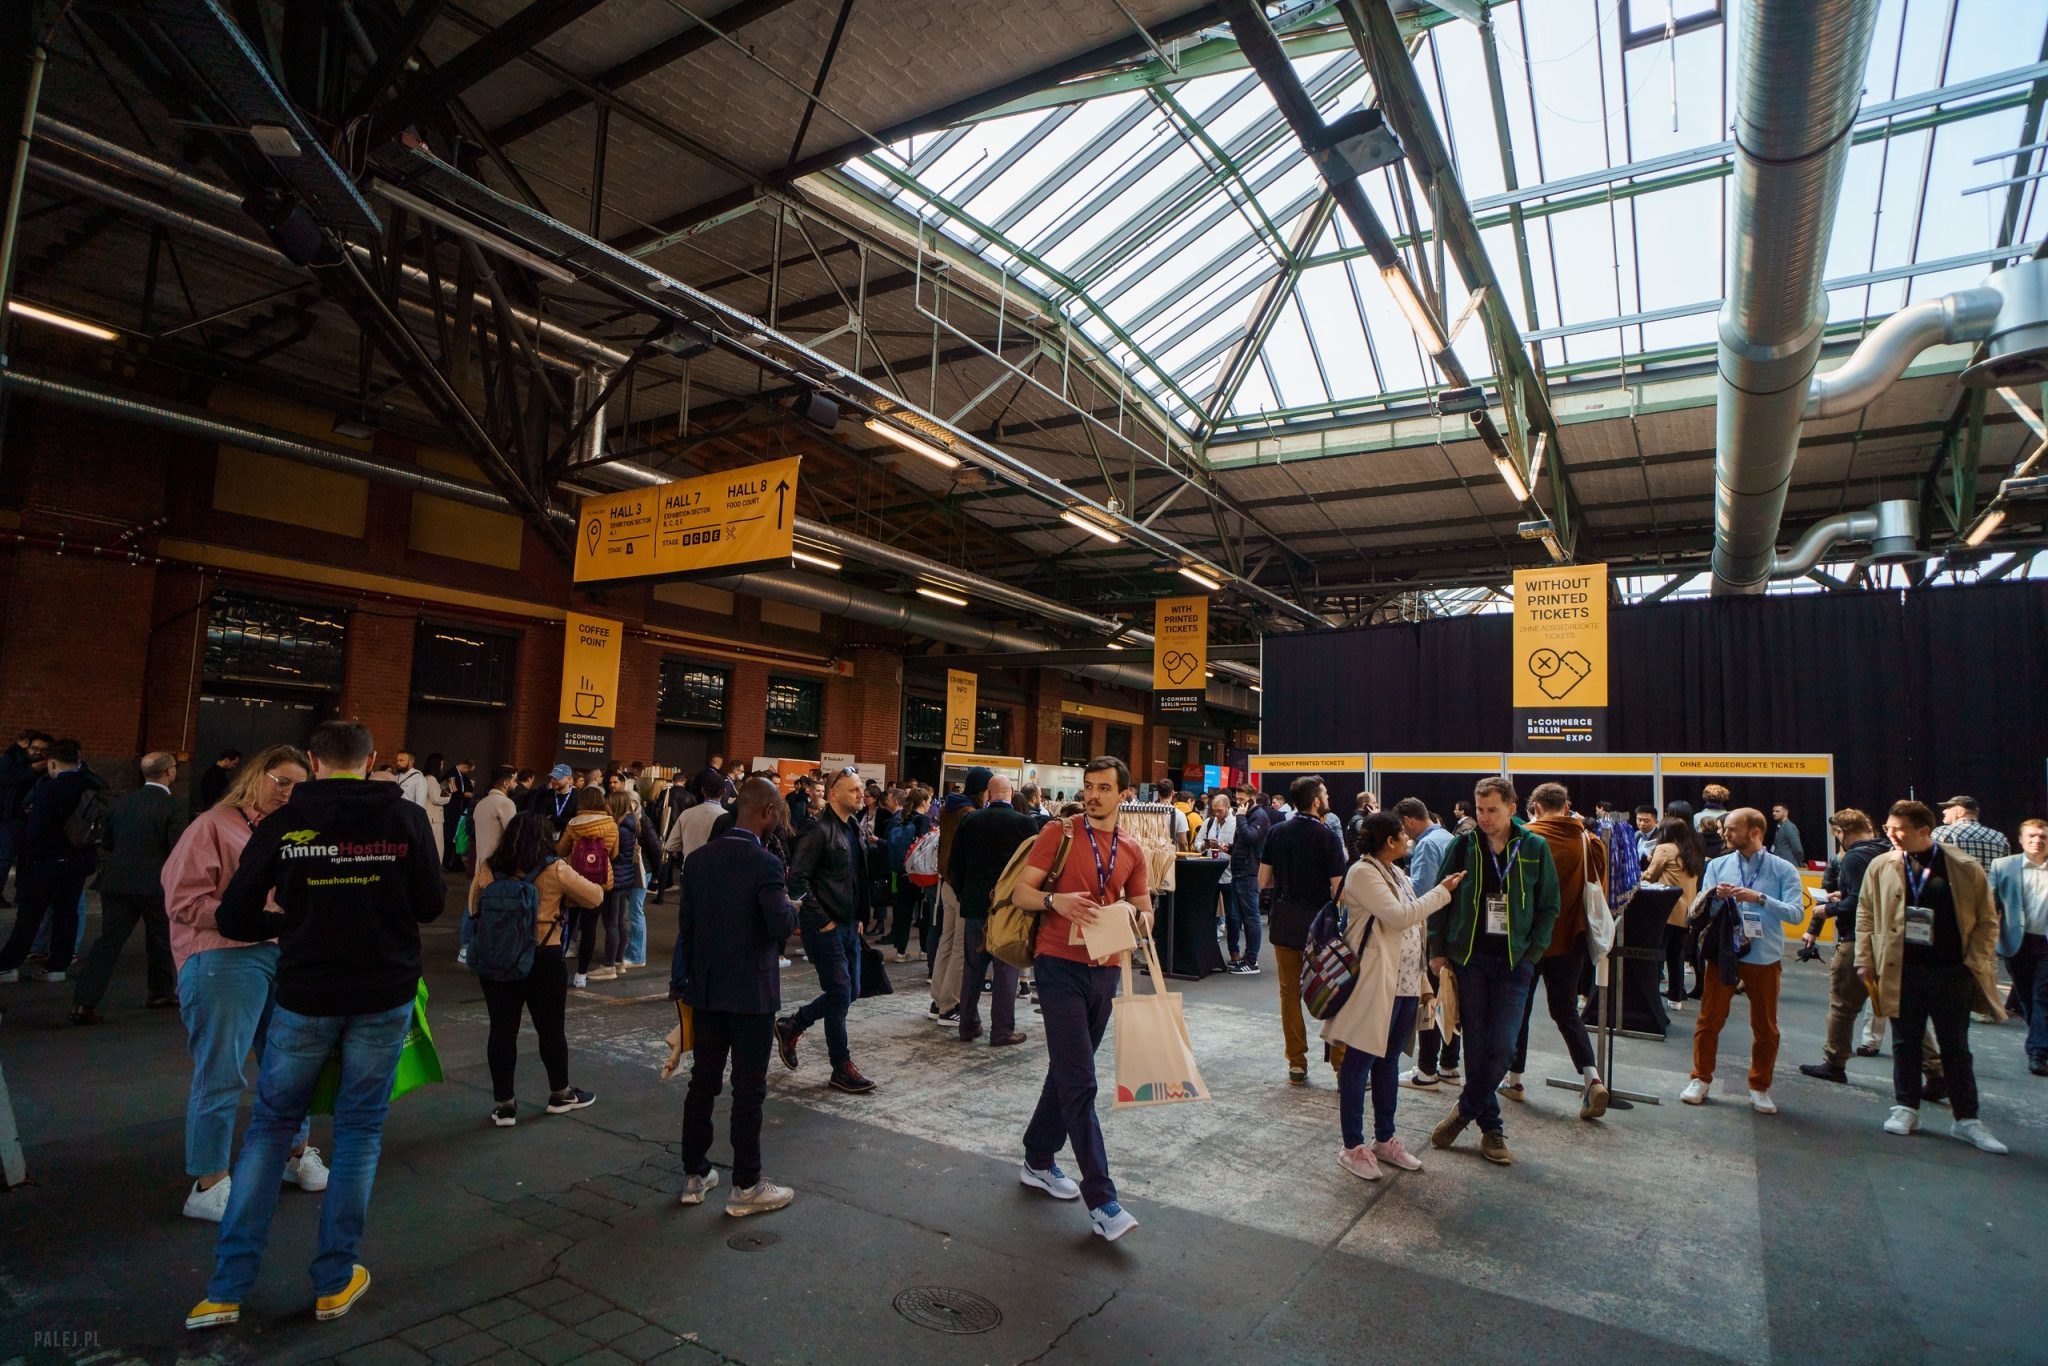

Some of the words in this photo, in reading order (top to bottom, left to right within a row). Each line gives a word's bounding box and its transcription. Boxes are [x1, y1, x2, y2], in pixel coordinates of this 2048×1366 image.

[728, 482, 757, 498] HALL
[761, 480, 767, 492] 8
[666, 494, 690, 509] HALL
[695, 492, 701, 504] 7
[742, 498, 760, 507] COURT
[610, 505, 633, 518] HALL
[636, 504, 642, 515] 3
[664, 510, 690, 519] EXHIBITION
[691, 507, 711, 516] SECTOR
[1525, 578, 1590, 591] WITHOUT
[1528, 593, 1587, 606] PRINTED
[1171, 605, 1192, 613] WITH
[1530, 607, 1589, 620] TICKETS
[1164, 615, 1198, 623] PRINTED
[578, 624, 610, 637] COFFEE
[1165, 625, 1198, 633] TICKETS
[580, 636, 607, 648] POINT
[280, 840, 409, 859] TimmeHosting
[331, 854, 396, 864] nginx-Webhosting
